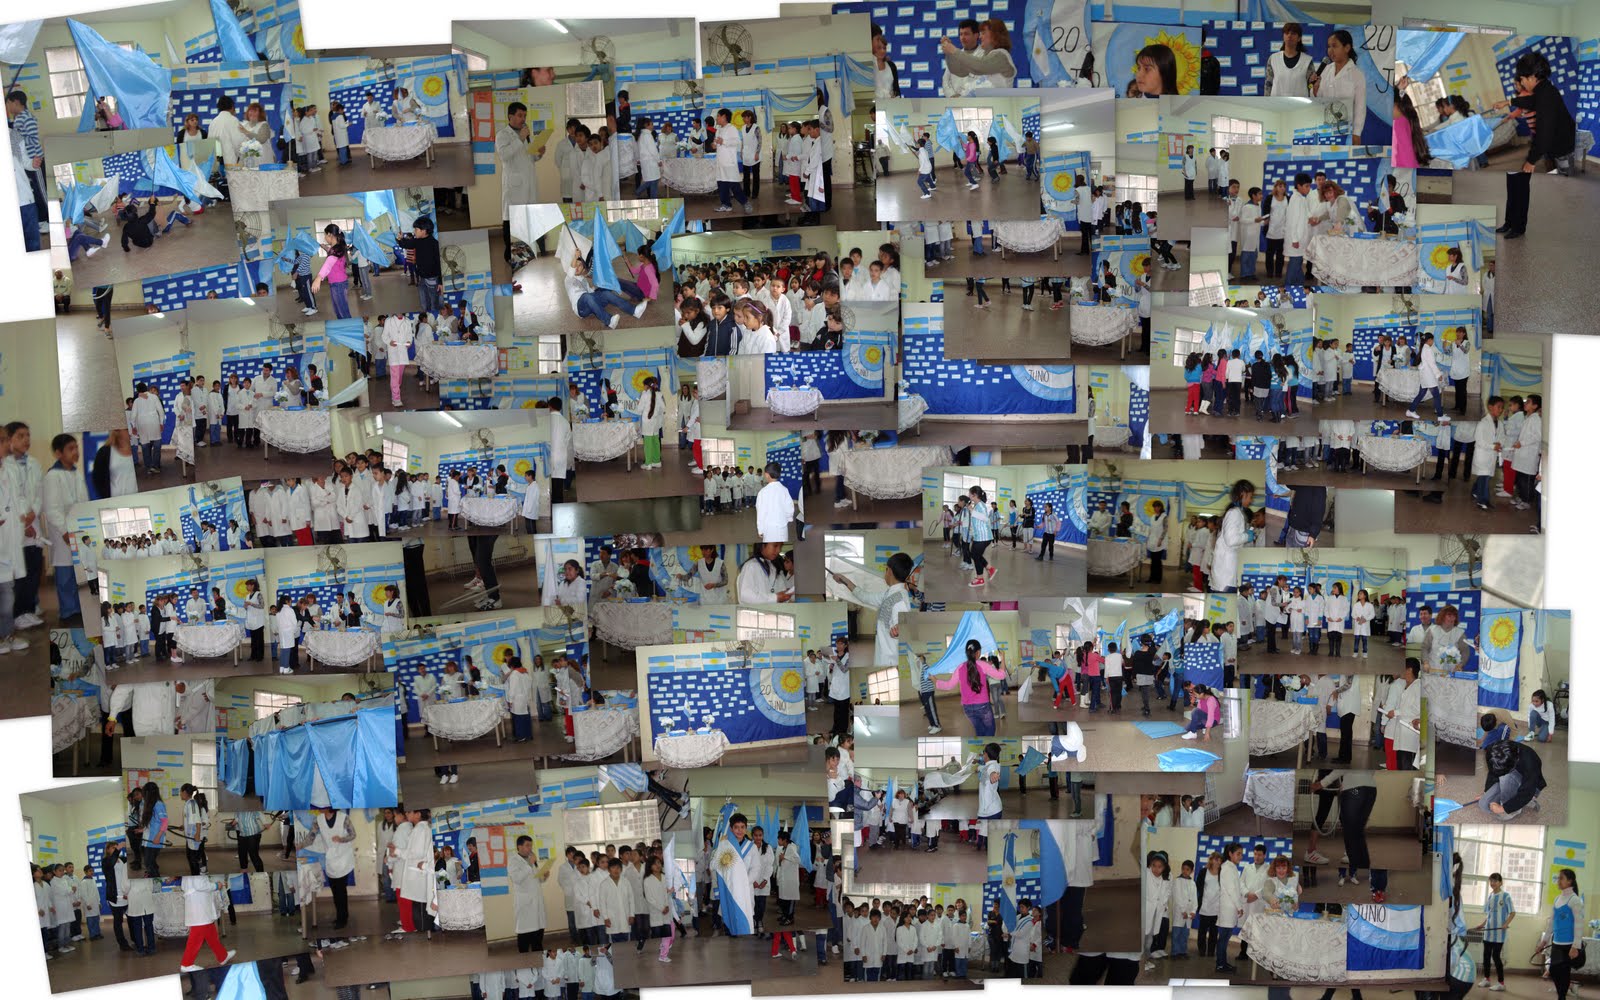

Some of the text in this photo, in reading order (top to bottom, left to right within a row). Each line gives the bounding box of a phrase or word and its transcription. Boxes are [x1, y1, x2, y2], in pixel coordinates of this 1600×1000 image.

[1048, 26, 1080, 53] 20
[1360, 25, 1393, 52] 20
[661, 553, 676, 568] 20
[759, 684, 773, 696] 20
[1349, 903, 1387, 923] JUNIO
